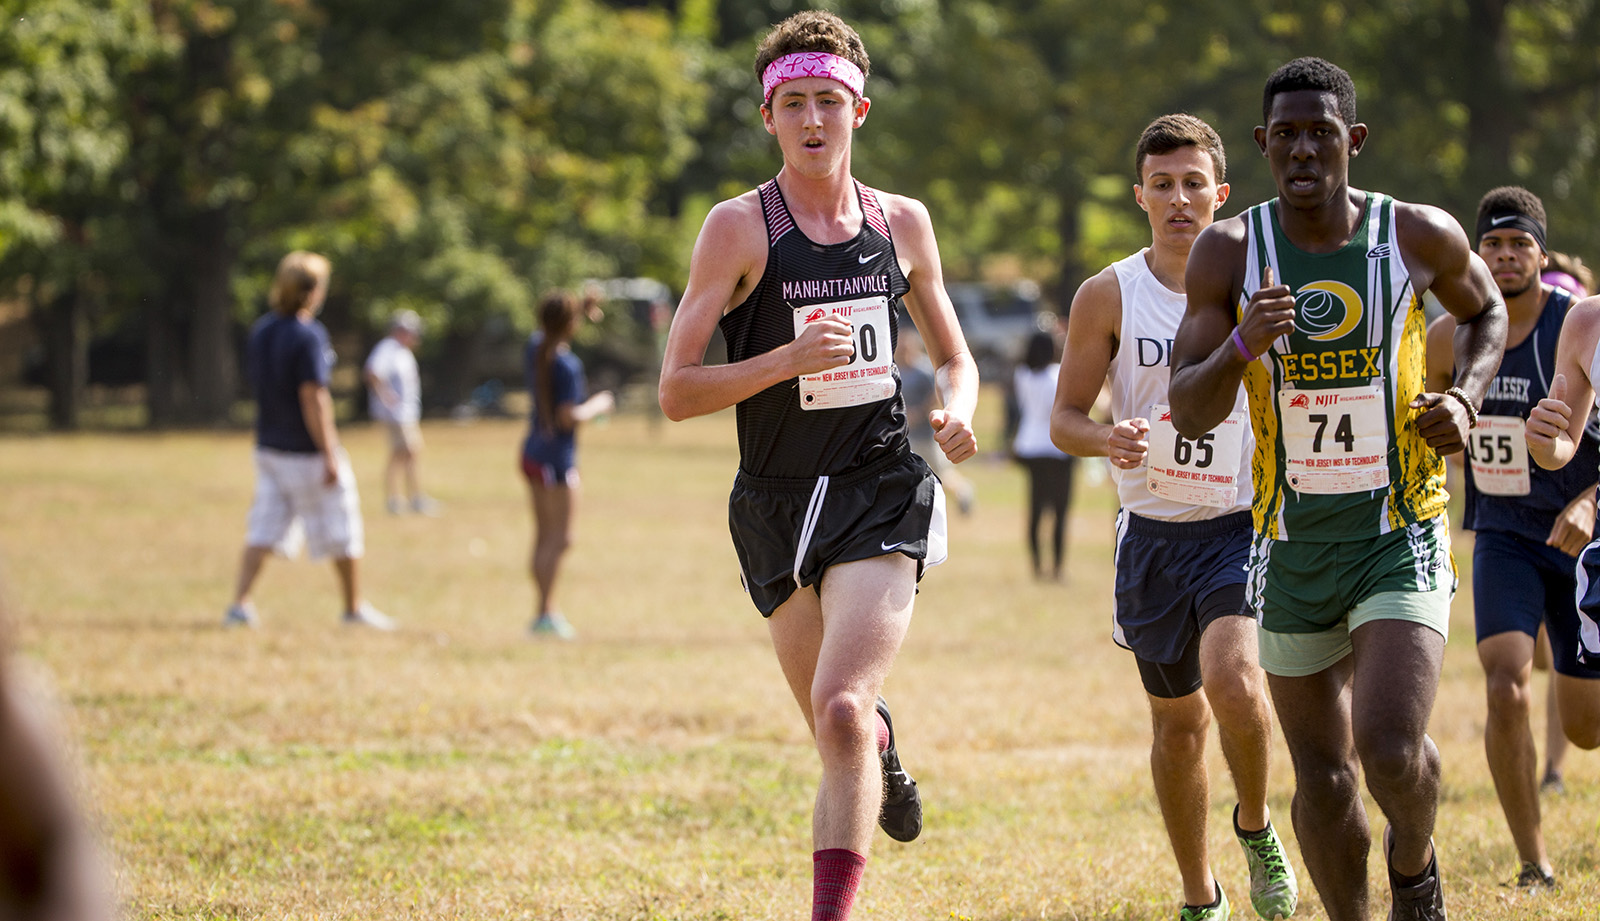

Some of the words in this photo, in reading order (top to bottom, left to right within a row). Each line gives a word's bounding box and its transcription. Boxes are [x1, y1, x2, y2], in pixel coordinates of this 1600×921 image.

[782, 275, 889, 299] MANHATTANVILLE
[822, 373, 832, 382] NEW
[833, 371, 849, 381] JERSEY
[850, 369, 860, 379] INST.
[860, 368, 866, 377] OF
[866, 365, 889, 377] TECHNOLOGY
[1280, 348, 1381, 382] ESSEX
[1315, 394, 1340, 408] NJIT
[1308, 413, 1355, 453] 74
[1174, 432, 1215, 468] 65
[1305, 458, 1315, 467] NEW
[1316, 458, 1332, 467] JERSEY
[1333, 458, 1344, 467] INST.
[1345, 457, 1351, 466] OF
[1352, 455, 1380, 466] TECHNOLOGY
[1468, 434, 1514, 464] 155
[1166, 468, 1175, 477] NEW
[1175, 470, 1191, 480] JERSEY
[1191, 472, 1201, 481] INST.
[1201, 473, 1207, 482] OF
[1208, 474, 1233, 484] TECHNOLOGY
